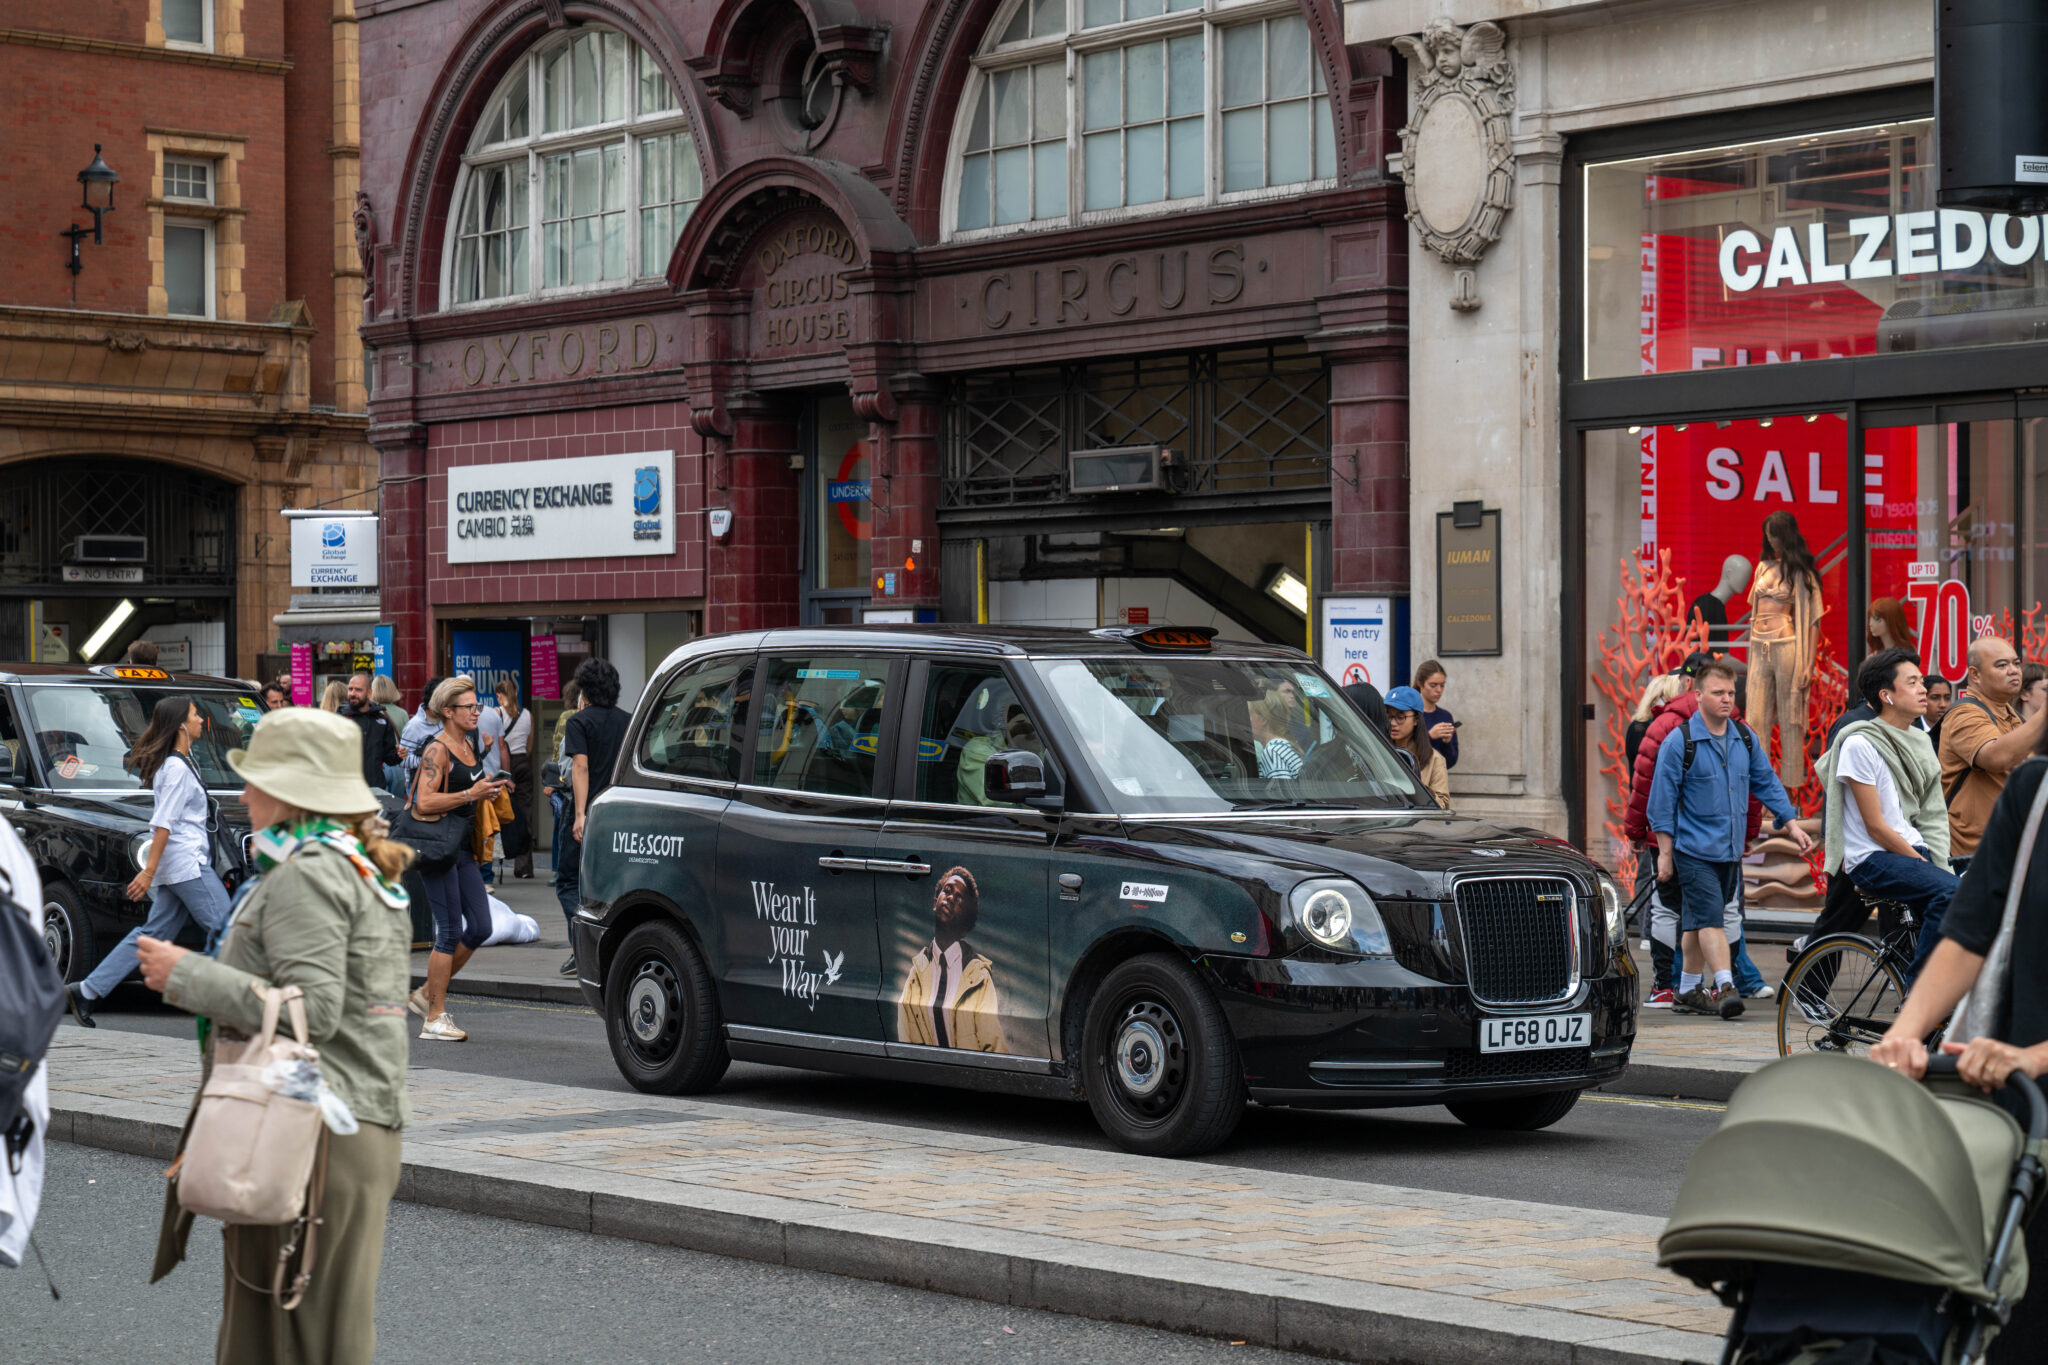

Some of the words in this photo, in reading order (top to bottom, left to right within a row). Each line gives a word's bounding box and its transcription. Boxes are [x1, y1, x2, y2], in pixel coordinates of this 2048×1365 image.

[760, 225, 855, 276] OXFORD
[1719, 208, 2048, 292] CALZEDO
[766, 273, 849, 309] CIRCUS
[982, 242, 1246, 330] CIRCUS
[765, 311, 850, 347] HOUSE
[1641, 293, 1654, 374] ALE
[461, 319, 656, 387] OXFORD
[1641, 425, 1655, 520] FINA
[1706, 447, 1884, 505] SALE
[456, 488, 530, 513] CURRENCY
[533, 482, 613, 509] EXCHANGE
[457, 517, 506, 539] CAMBIO
[633, 519, 661, 531] Global
[633, 530, 661, 541] Exchange
[1447, 549, 1491, 564] IUMAN
[1912, 564, 1922, 575] UP
[1925, 564, 1935, 575] TO
[85, 569, 100, 579] NO
[106, 569, 137, 579] ENTRY
[311, 574, 358, 583] EXCHANGE
[1447, 614, 1492, 623] CALZEDONIA
[1147, 632, 1206, 643] TAXI
[1334, 627, 1349, 639] No
[1351, 628, 1380, 642] entry
[456, 655, 470, 668] GET
[471, 655, 491, 668] YOUR
[1345, 648, 1368, 660] here
[117, 669, 165, 678] TAXI
[751, 880, 801, 923] Wear
[803, 886, 818, 926] It
[767, 925, 809, 965] your
[781, 958, 824, 1013] Way.
[1488, 1020, 1540, 1048] LF68
[1545, 1017, 1583, 1043] OJZ
